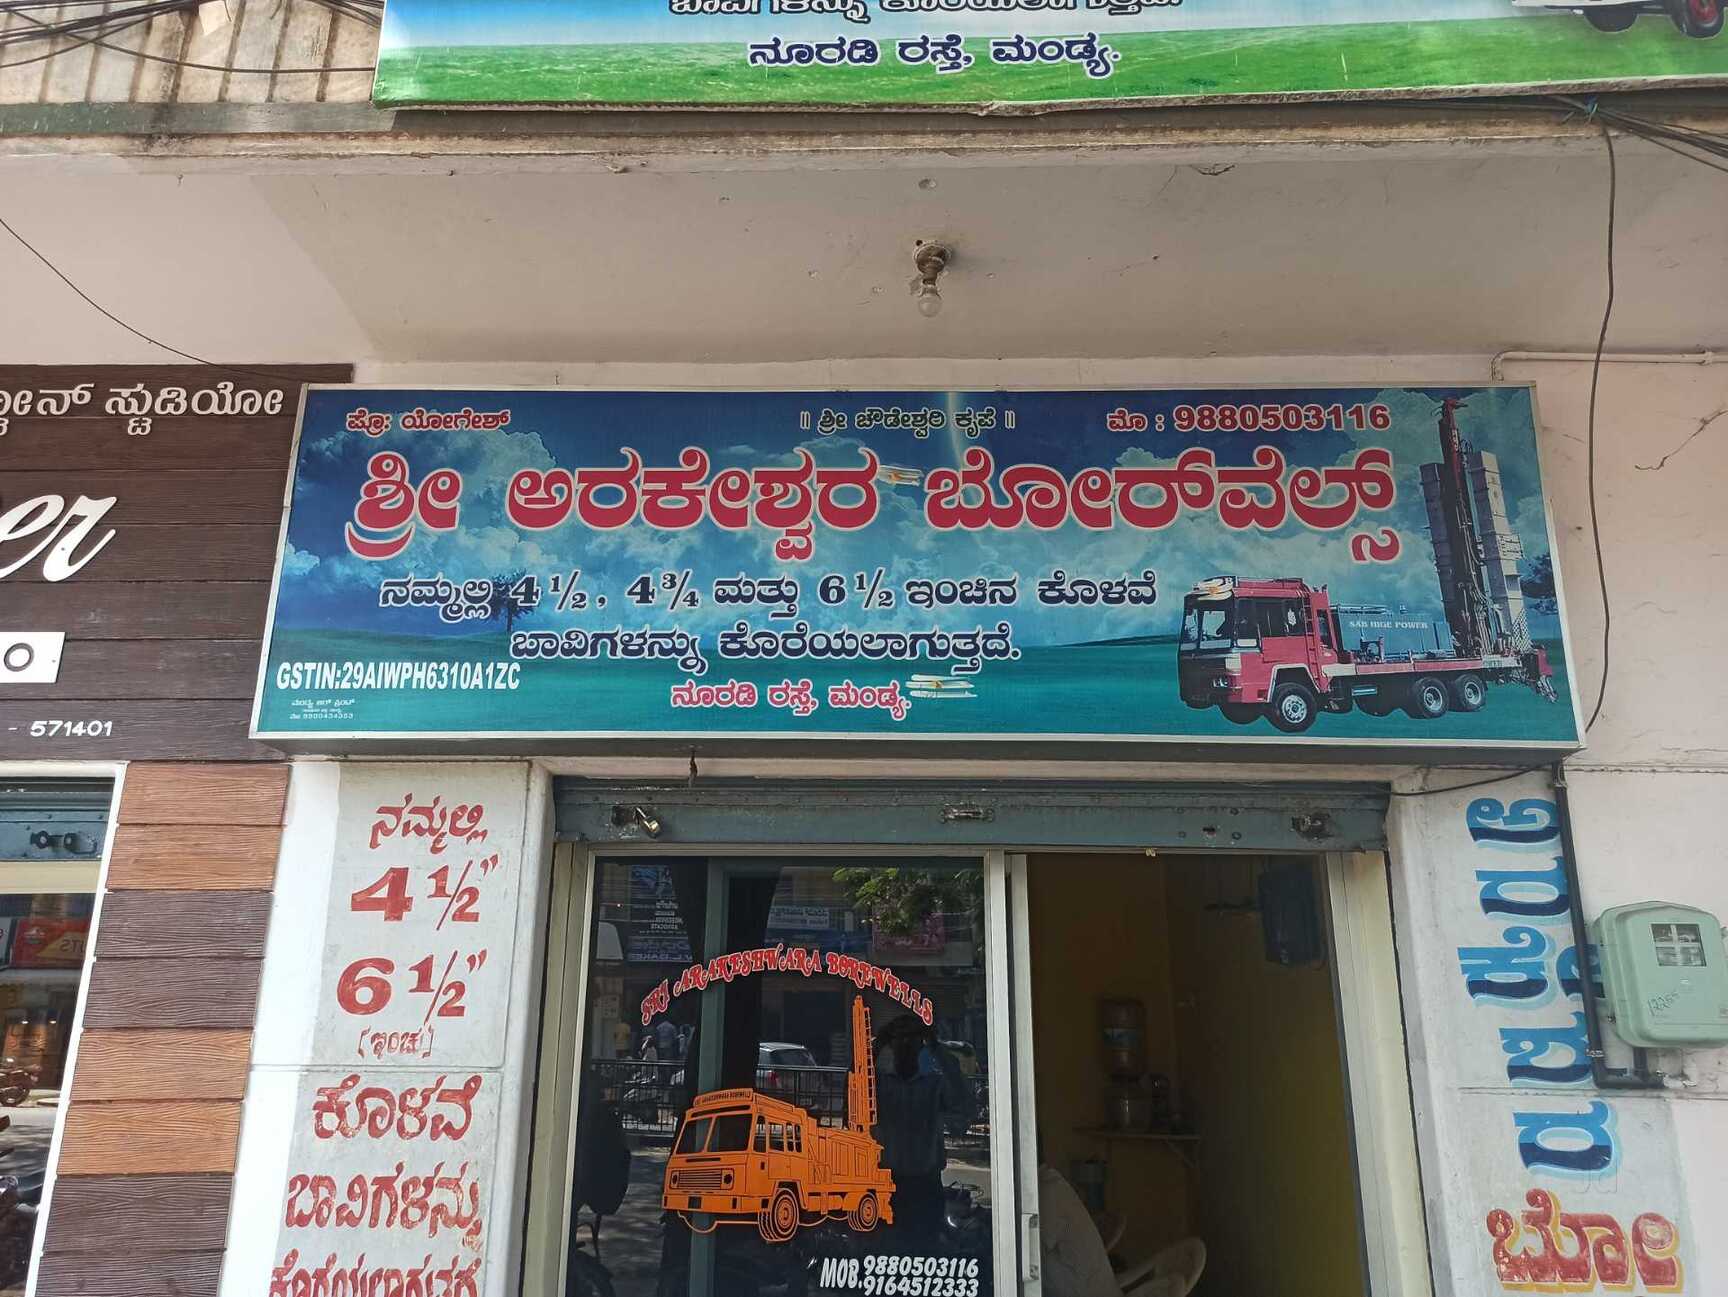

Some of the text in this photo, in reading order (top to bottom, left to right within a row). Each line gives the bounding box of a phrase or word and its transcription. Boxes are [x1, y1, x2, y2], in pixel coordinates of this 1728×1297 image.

[747, 36, 879, 66] ನೂರಡಿ
[897, 33, 975, 73] ರಸ್ತೆ,
[105, 381, 284, 435] ಸ್ಟುಡಿಯೋ
[400, 407, 511, 431] ಯೋಗೇಶ್
[816, 408, 848, 435] ಶ್ರೀ
[954, 406, 997, 438] ಕೃಪೆ
[1173, 404, 1392, 432] 9880503116
[344, 450, 463, 560] ಶ್ರೀ
[506, 447, 880, 561] ಅರಕೇಶ್ವರ
[379, 573, 493, 623] ನಮ್ಮಲ್ಲಿ
[713, 574, 799, 619] ಮತ್ತು
[904, 574, 1017, 609] ಇಂಚಿನ
[1037, 569, 1158, 606] ಕೊಳವೆ
[509, 624, 708, 675] ಬಾವಿಗಳನ್ನು
[671, 679, 759, 708] ನೂರಡಿ
[30, 720, 113, 737] 571401
[368, 792, 488, 854] ನಮ್ಮಲ್ಲಿ
[641, 943, 934, 1026] SRI ARAKESHWARA BOREWELLS
[312, 1072, 483, 1141] ಕೊಳವೆ
[820, 1255, 979, 1289] MOB. 9880503116
[863, 1275, 979, 1297] 9164512333
